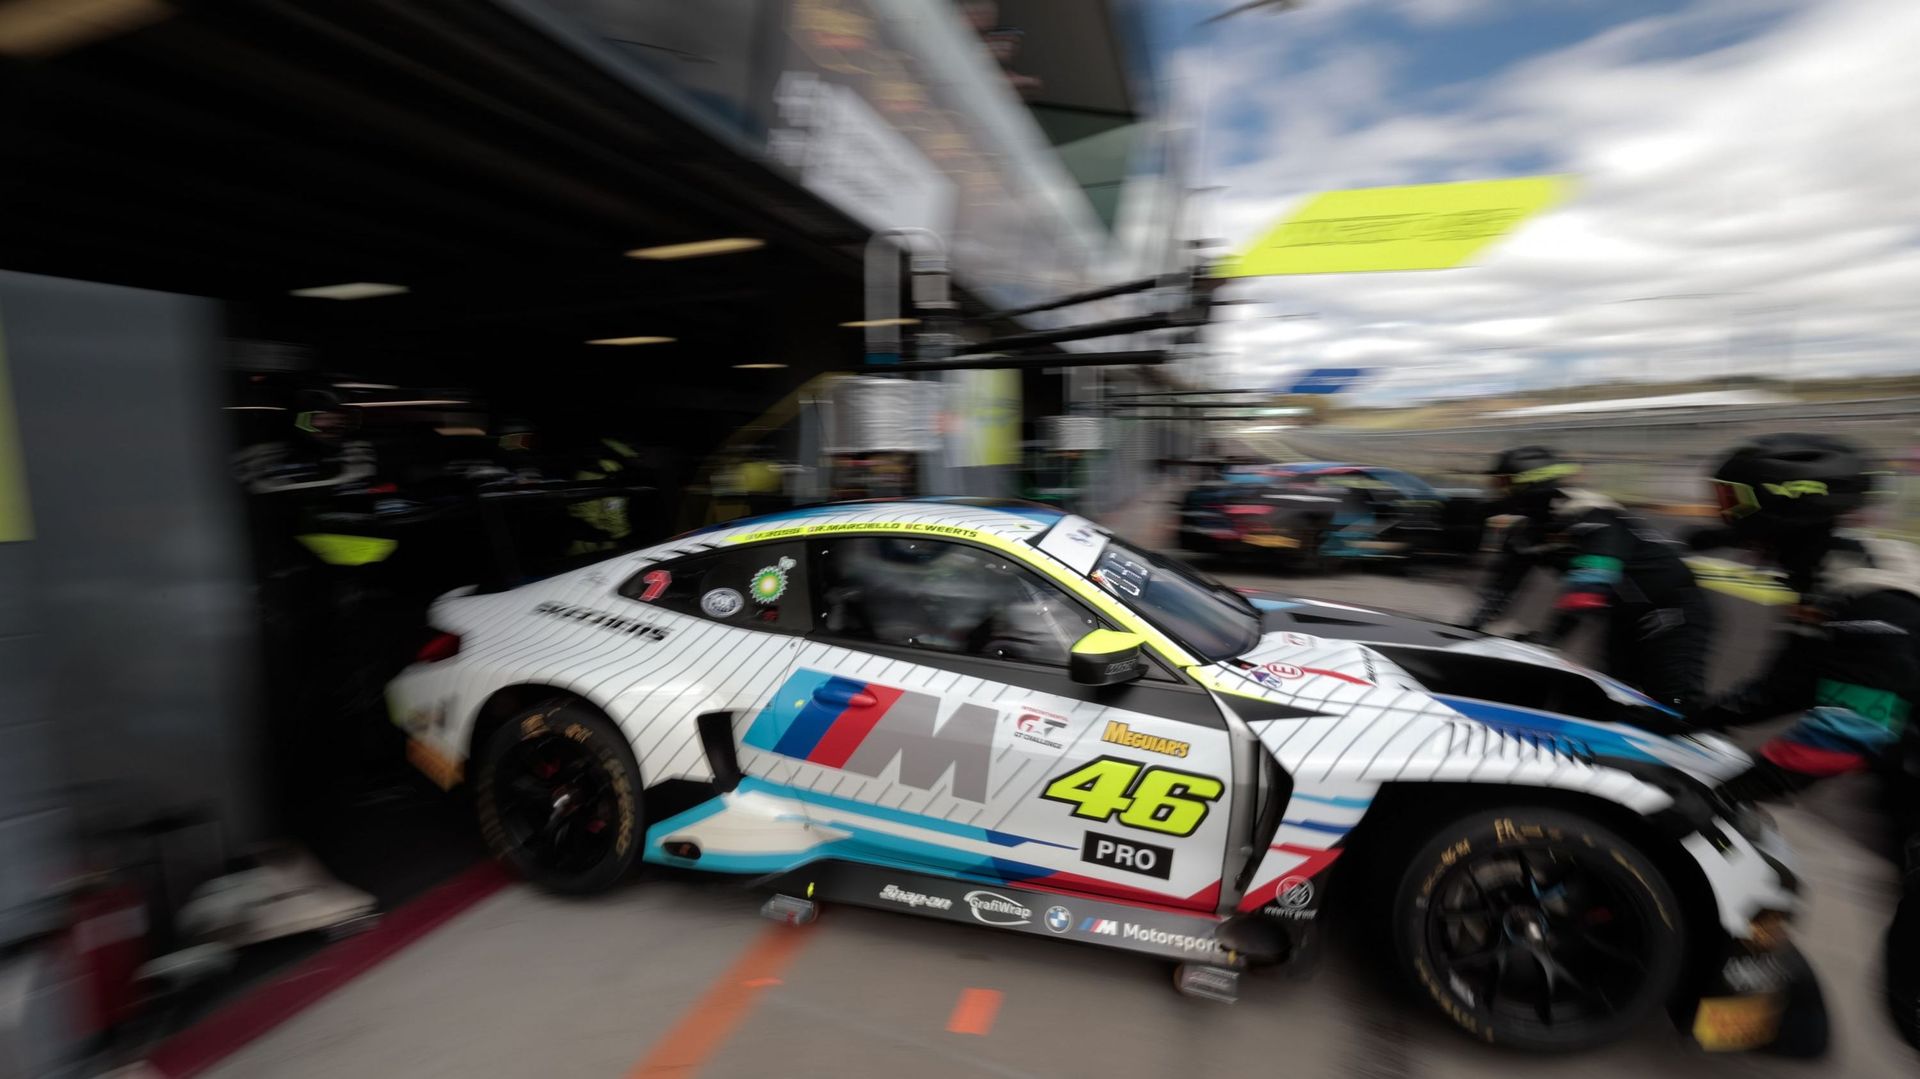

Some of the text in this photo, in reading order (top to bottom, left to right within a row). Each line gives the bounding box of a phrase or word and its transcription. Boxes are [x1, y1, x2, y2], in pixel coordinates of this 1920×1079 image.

[814, 522, 900, 532] R.MARCIELLO
[911, 524, 978, 538] C.WEERTS
[841, 690, 999, 804] M
[1023, 734, 1064, 749] CHALLENGE
[1040, 754, 1225, 838] 46
[1095, 840, 1157, 871] PRO
[879, 884, 953, 910] Snap-on
[969, 896, 1032, 919] GrafiWrap
[1123, 922, 1222, 952] Motorsport
